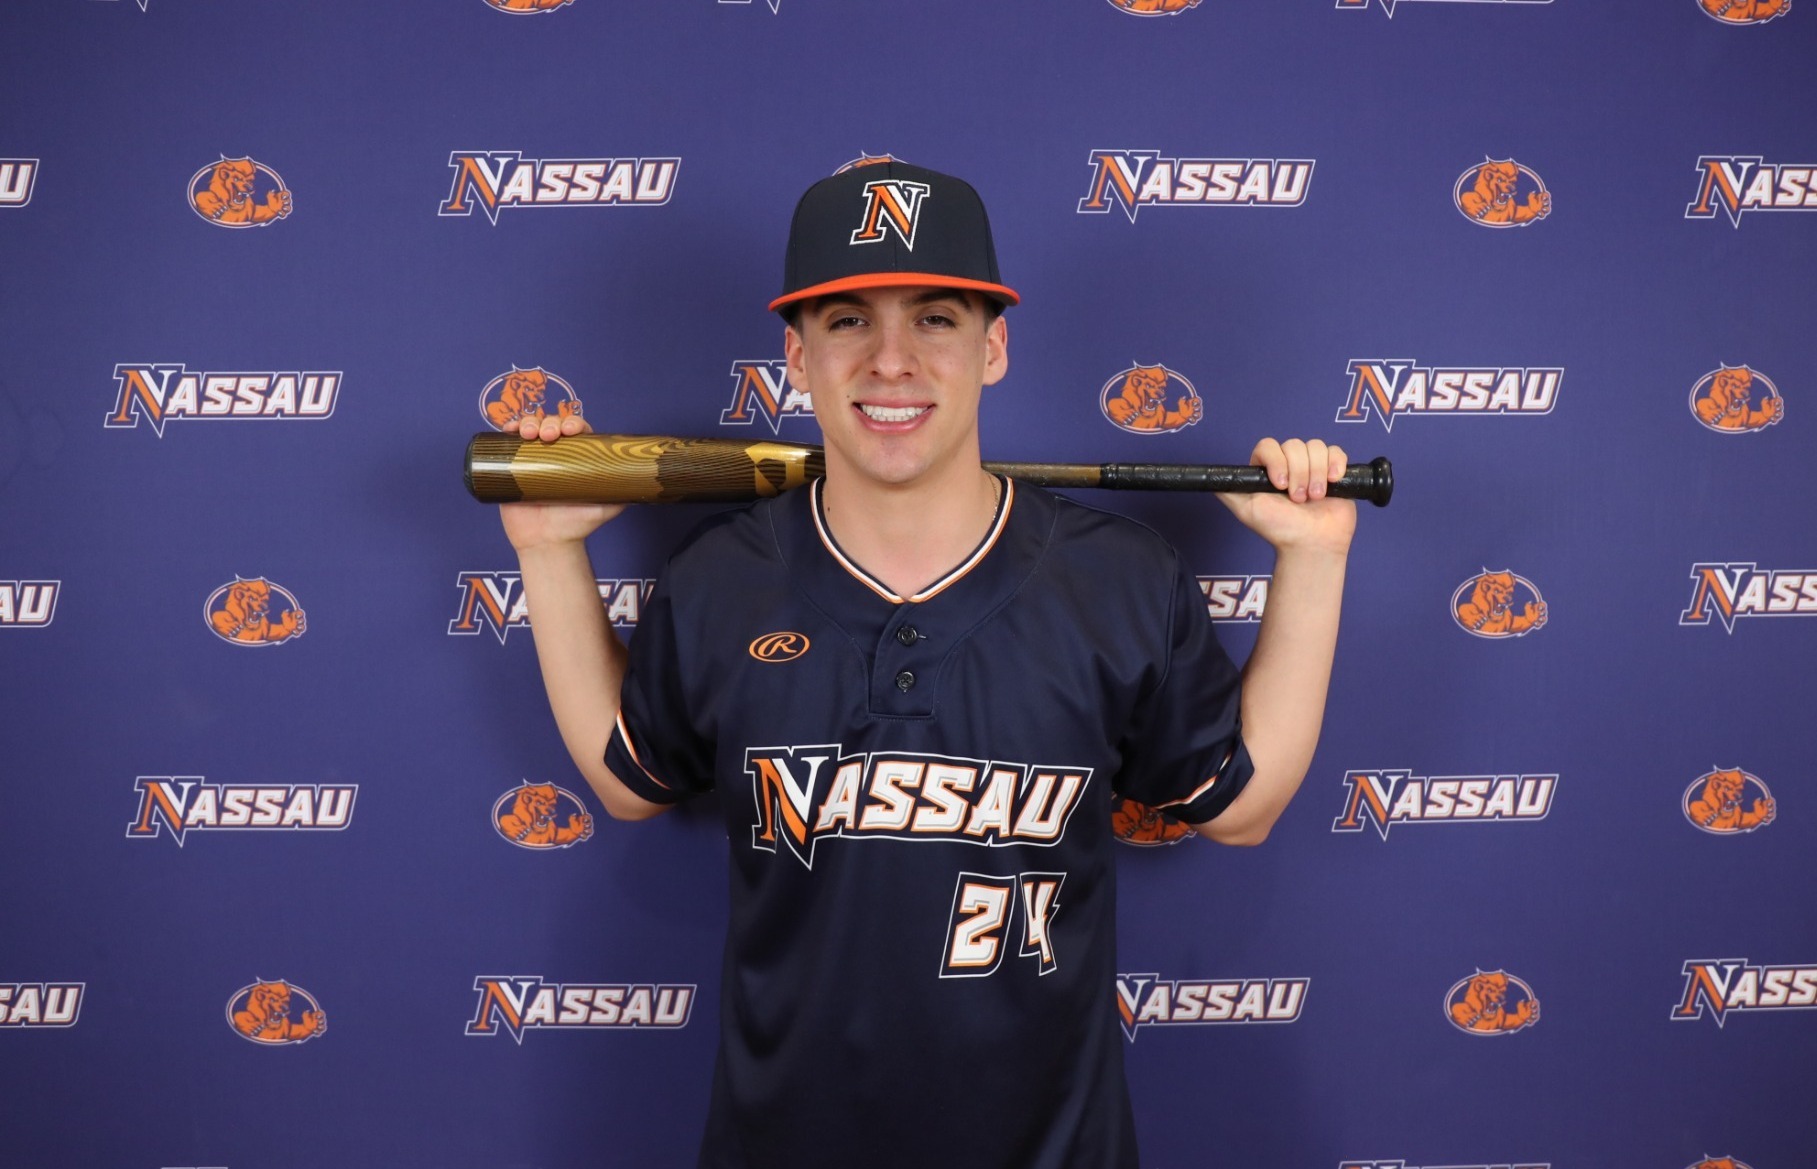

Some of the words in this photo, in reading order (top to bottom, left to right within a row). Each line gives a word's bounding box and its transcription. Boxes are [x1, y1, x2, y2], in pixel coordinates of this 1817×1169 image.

[438, 151, 682, 226] NASSAU
[849, 180, 930, 251] N
[1077, 149, 1316, 224] NASSAU
[104, 363, 343, 438] NASSAU
[1335, 359, 1564, 433] NASSAU
[126, 776, 359, 847] NASSAU
[744, 744, 1094, 870] NASSAU
[1331, 769, 1559, 841] NASSAU
[939, 871, 1067, 979] 24
[465, 976, 697, 1045] NASSAU
